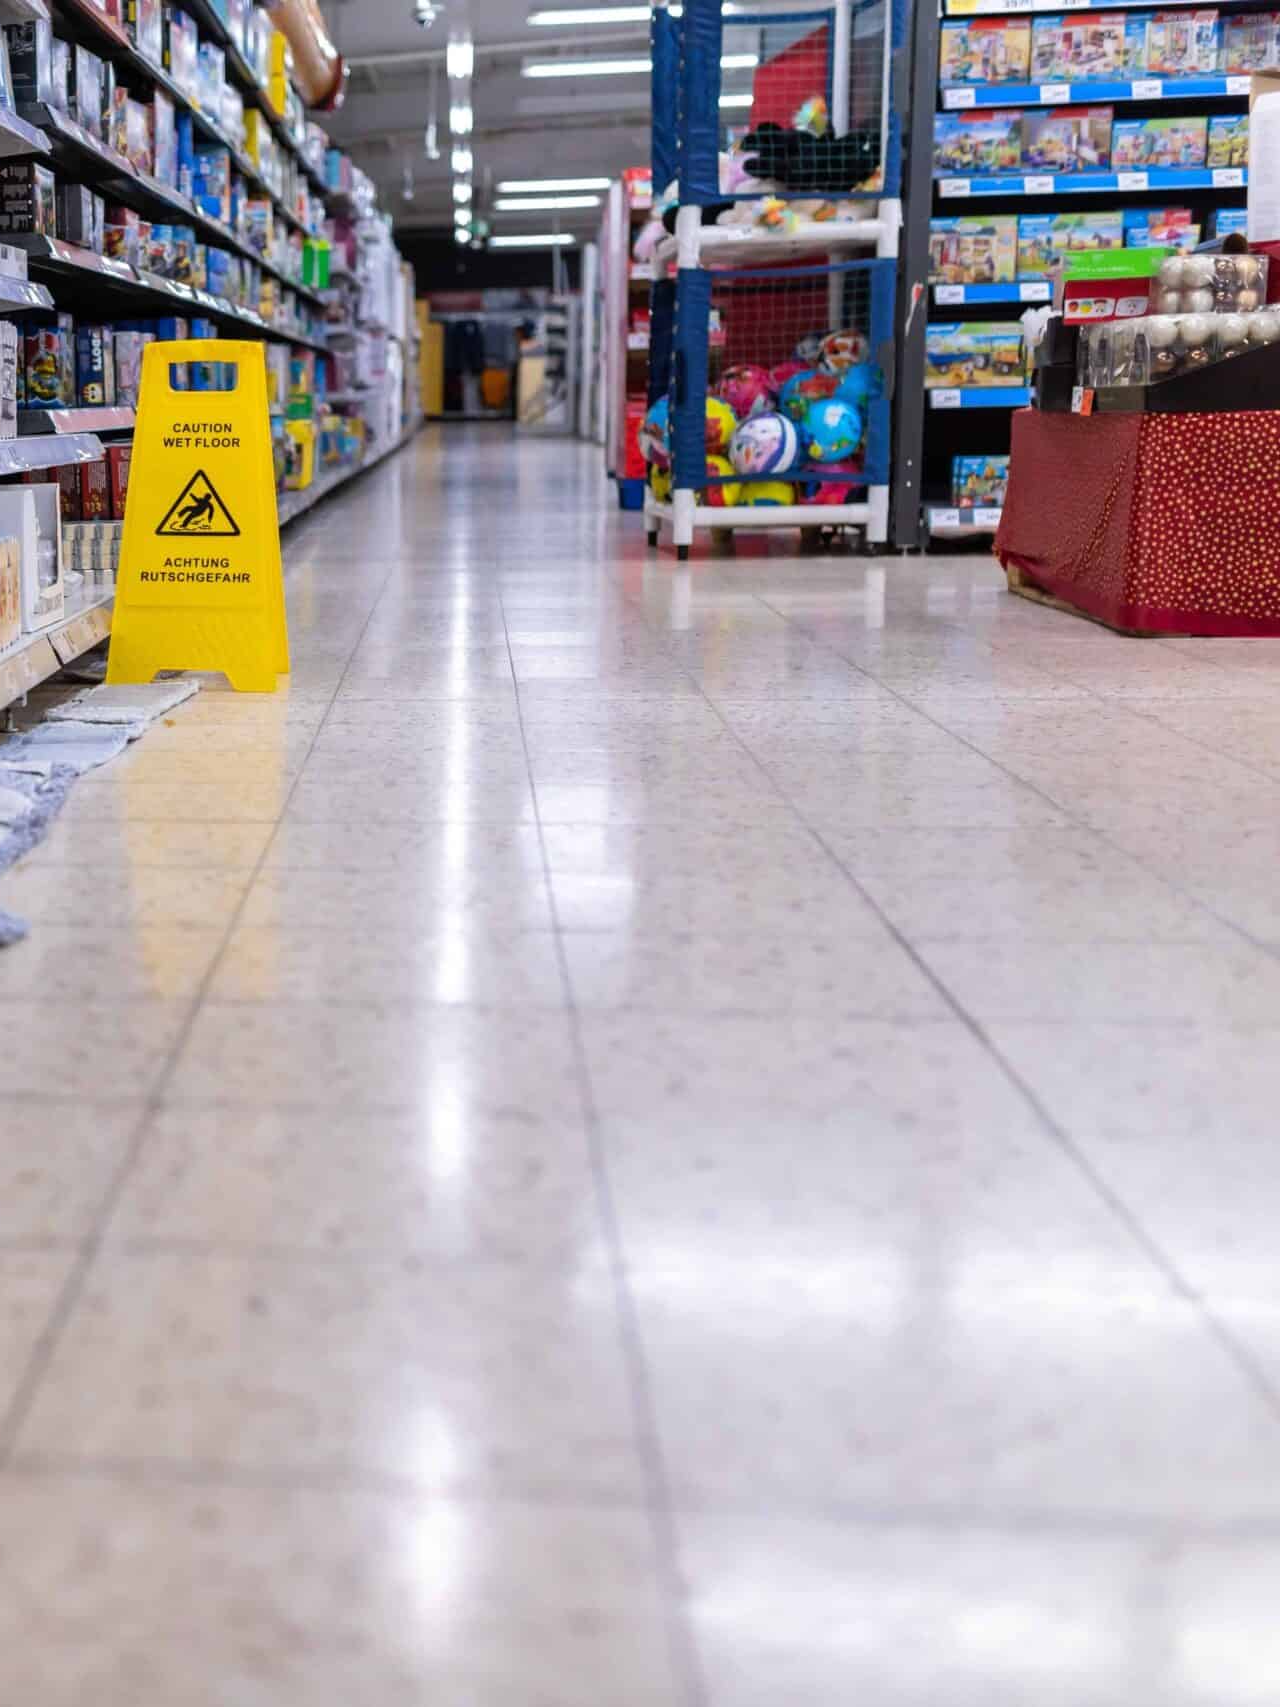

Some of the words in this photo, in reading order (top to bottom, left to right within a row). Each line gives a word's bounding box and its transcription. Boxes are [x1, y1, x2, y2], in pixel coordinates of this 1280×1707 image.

[172, 423, 232, 433] CAUTION
[163, 437, 192, 448] WET
[194, 437, 240, 448] FLOOR
[164, 557, 230, 569] ACHTUNG
[140, 571, 251, 583] RUTSCHGEFAHR
